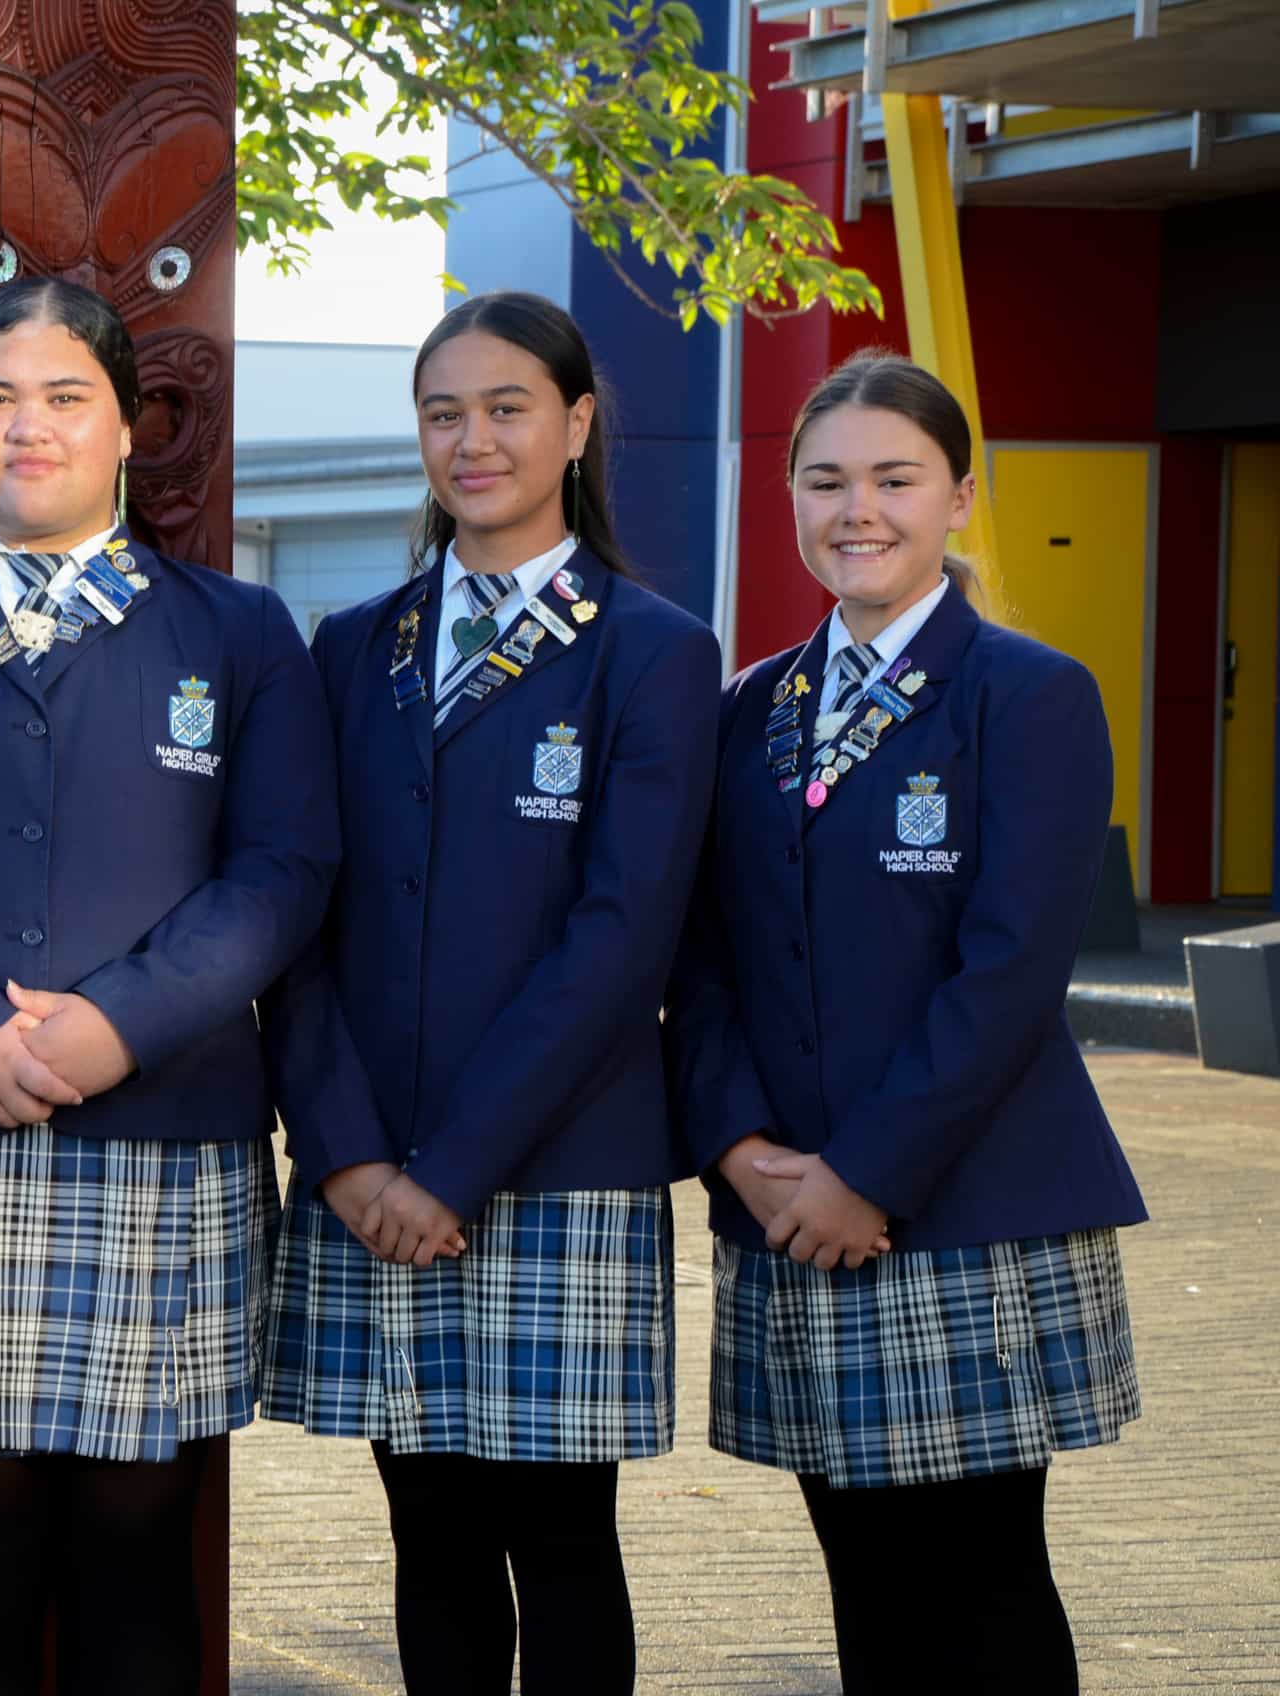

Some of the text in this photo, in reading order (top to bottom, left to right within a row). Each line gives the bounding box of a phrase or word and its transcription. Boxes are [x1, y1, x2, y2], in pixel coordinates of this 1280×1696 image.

[155, 744, 221, 768] NAPIER GIRLS'
[161, 757, 215, 777] HIGH SCHOOL
[515, 795, 558, 809] NAPIER
[520, 807, 547, 819] HIGH
[879, 850, 962, 863] NAPIER GIRLS'
[886, 862, 955, 873] HIGH SCHOOL
